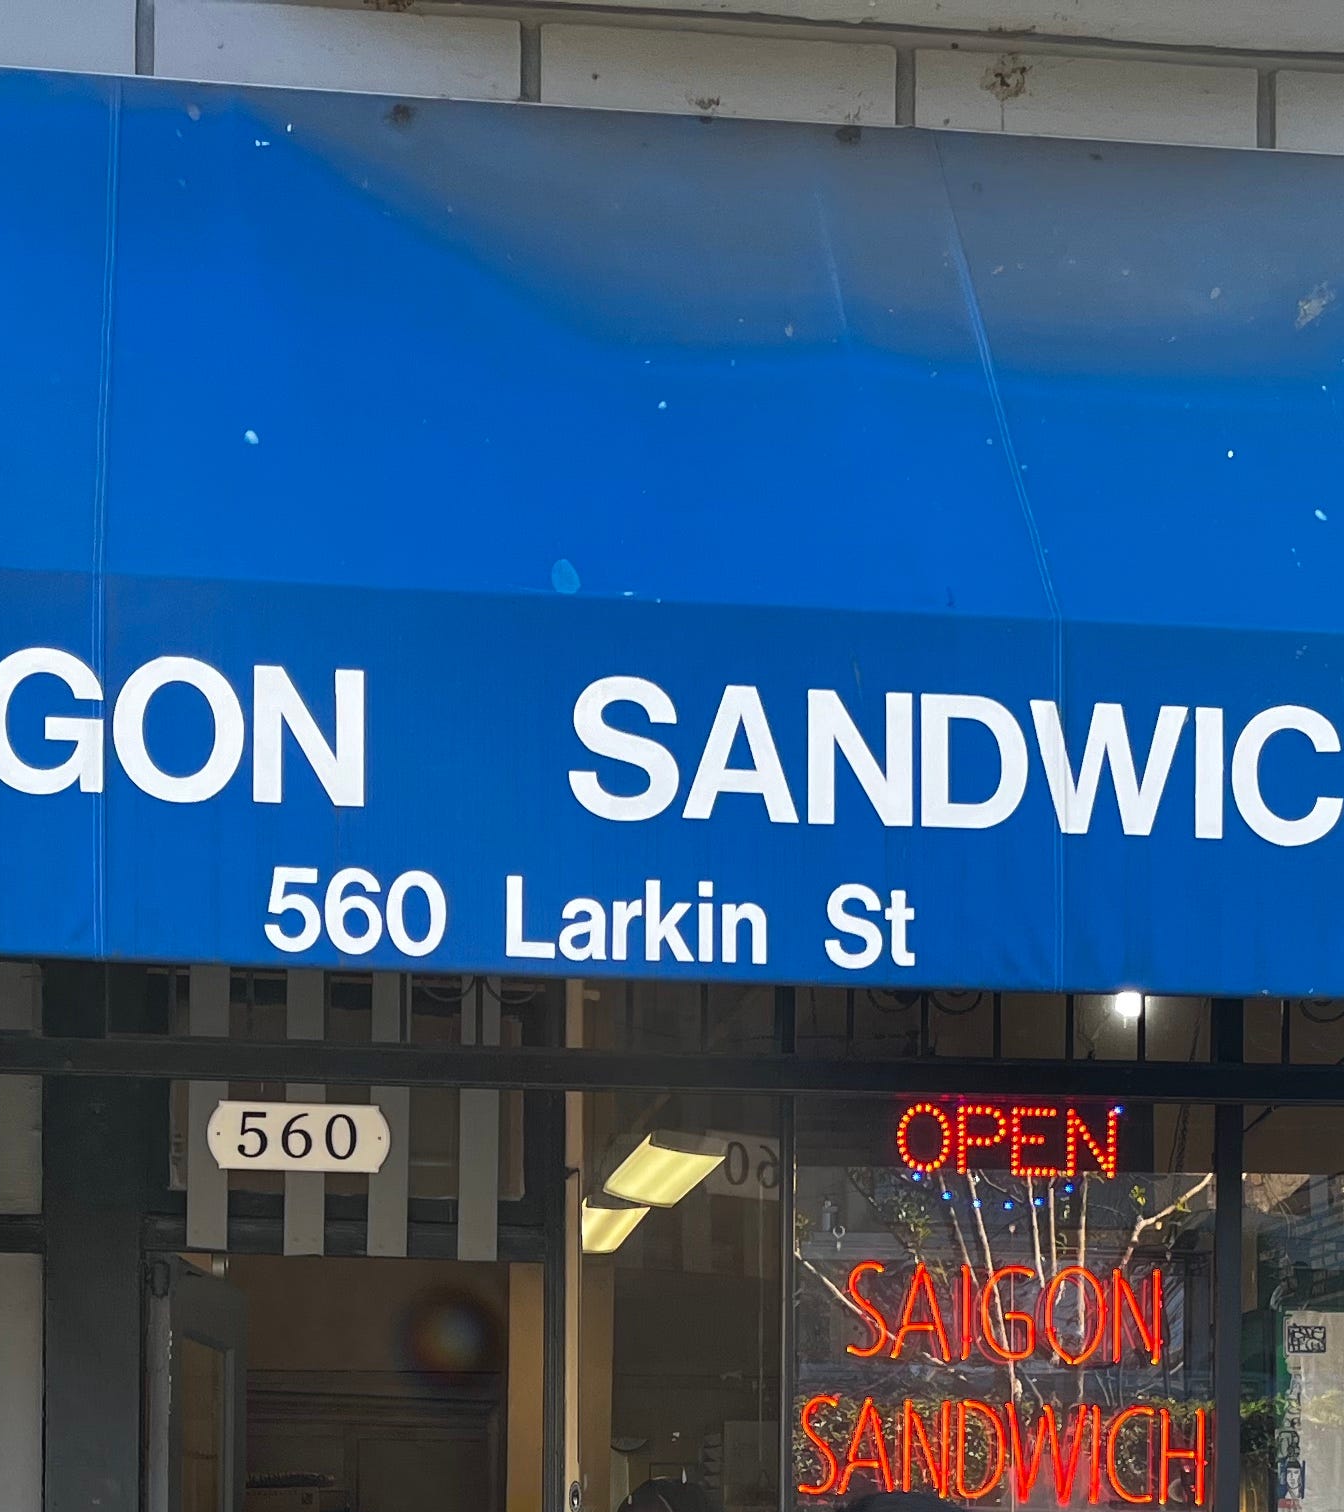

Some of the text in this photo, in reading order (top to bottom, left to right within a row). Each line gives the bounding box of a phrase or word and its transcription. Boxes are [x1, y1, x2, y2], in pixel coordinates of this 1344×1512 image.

[263, 864, 916, 969] 560 Larkin St
[237, 1111, 357, 1160] 560
[896, 1103, 1120, 1178] OPEN
[846, 1261, 1163, 1365] SAIGON
[797, 1394, 1206, 1508] SANDWICH
